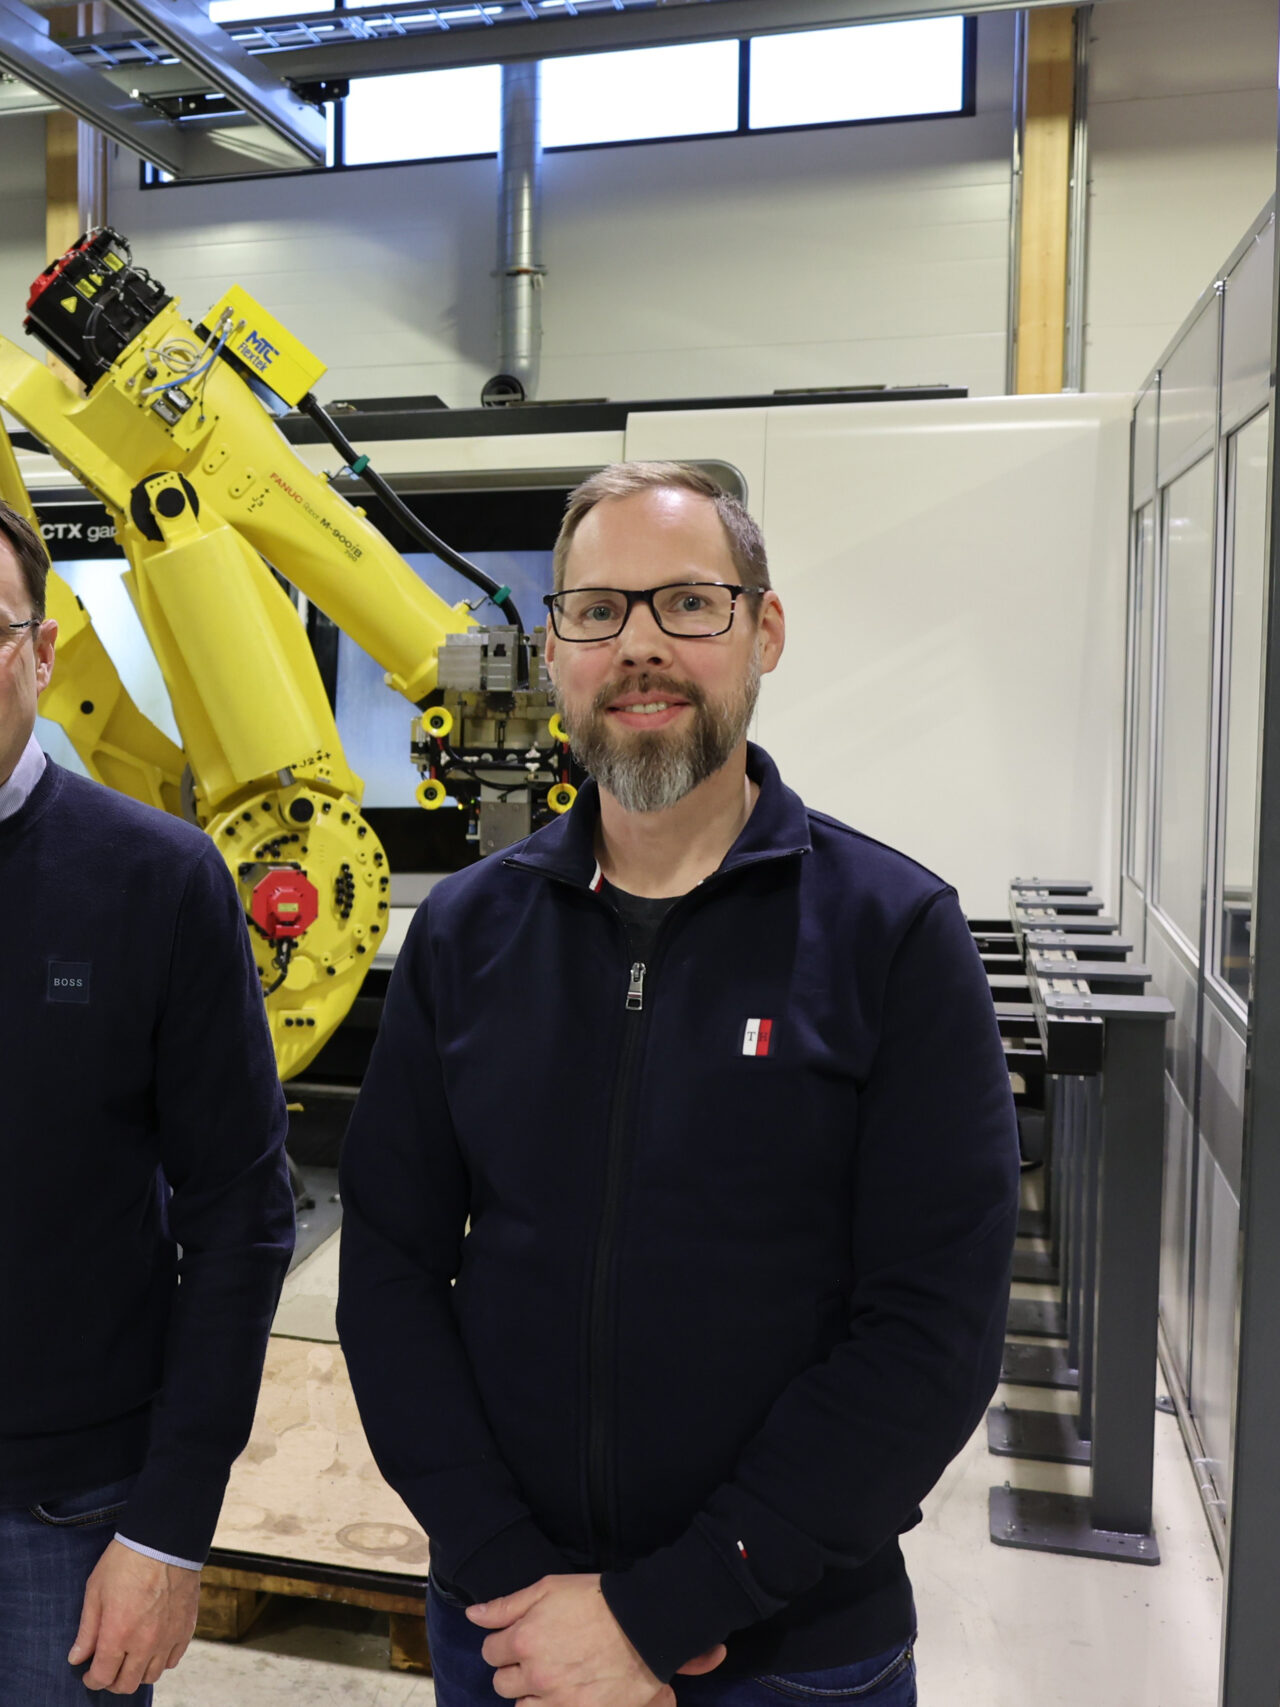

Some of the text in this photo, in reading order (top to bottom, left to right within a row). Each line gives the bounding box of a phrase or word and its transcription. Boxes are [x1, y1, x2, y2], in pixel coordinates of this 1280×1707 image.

[236, 341, 268, 373] Flextek
[245, 330, 280, 364] MTC
[269, 472, 303, 504] FANUC
[40, 523, 82, 540] CTX
[53, 977, 83, 987] BOSS
